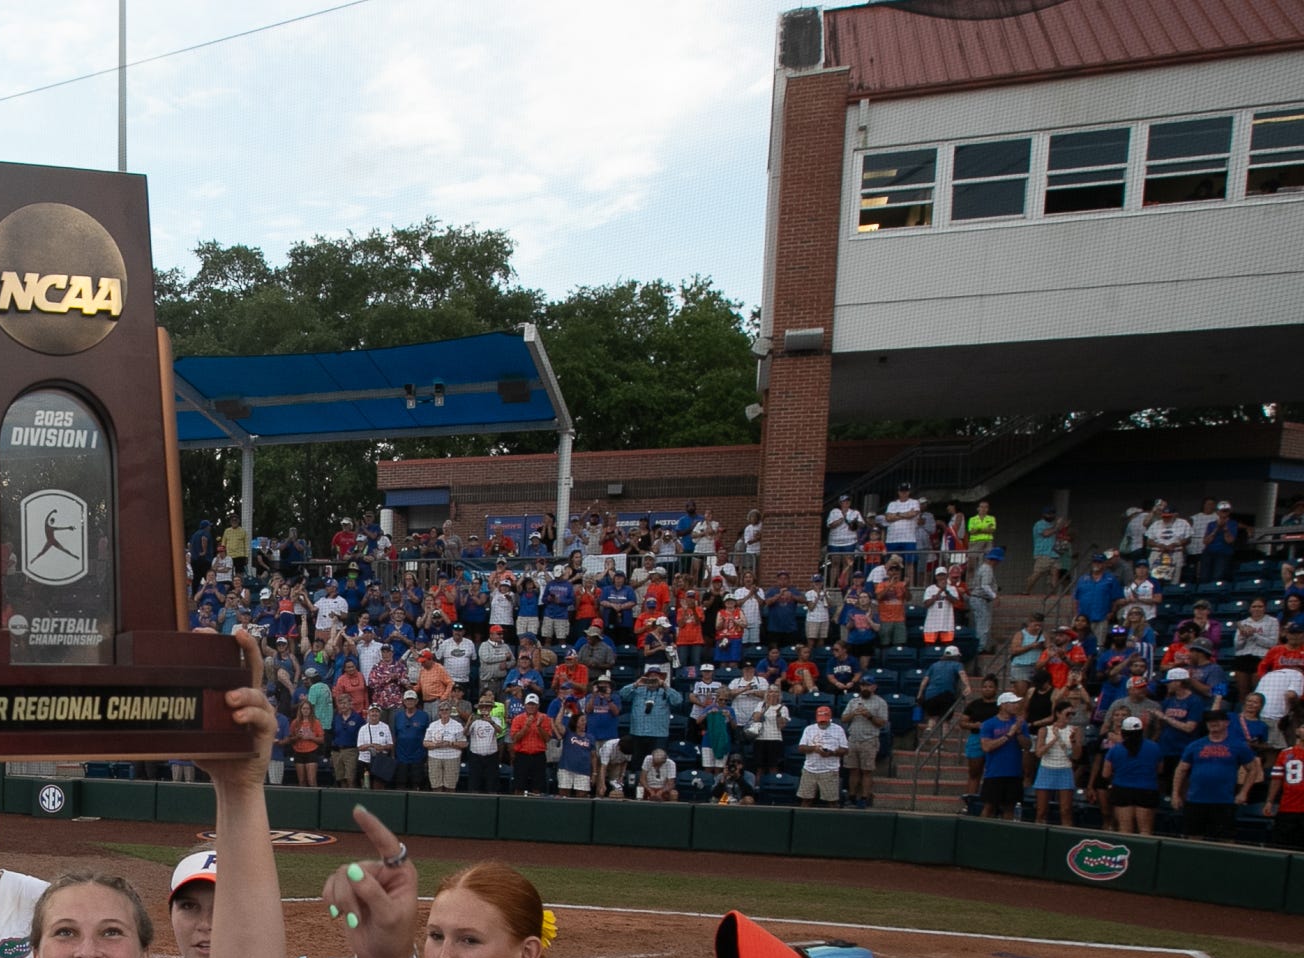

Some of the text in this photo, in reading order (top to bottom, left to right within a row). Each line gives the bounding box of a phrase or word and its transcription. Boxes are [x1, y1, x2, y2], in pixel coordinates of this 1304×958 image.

[34, 410, 74, 427] 2025
[11, 427, 98, 448] DIVISION I
[31, 617, 98, 633] SOFTBALL
[29, 634, 103, 645] CHAMPIONSHIP
[12, 696, 102, 721] REGIONAL
[107, 697, 196, 721] CHAMPION
[41, 786, 63, 812] SEC
